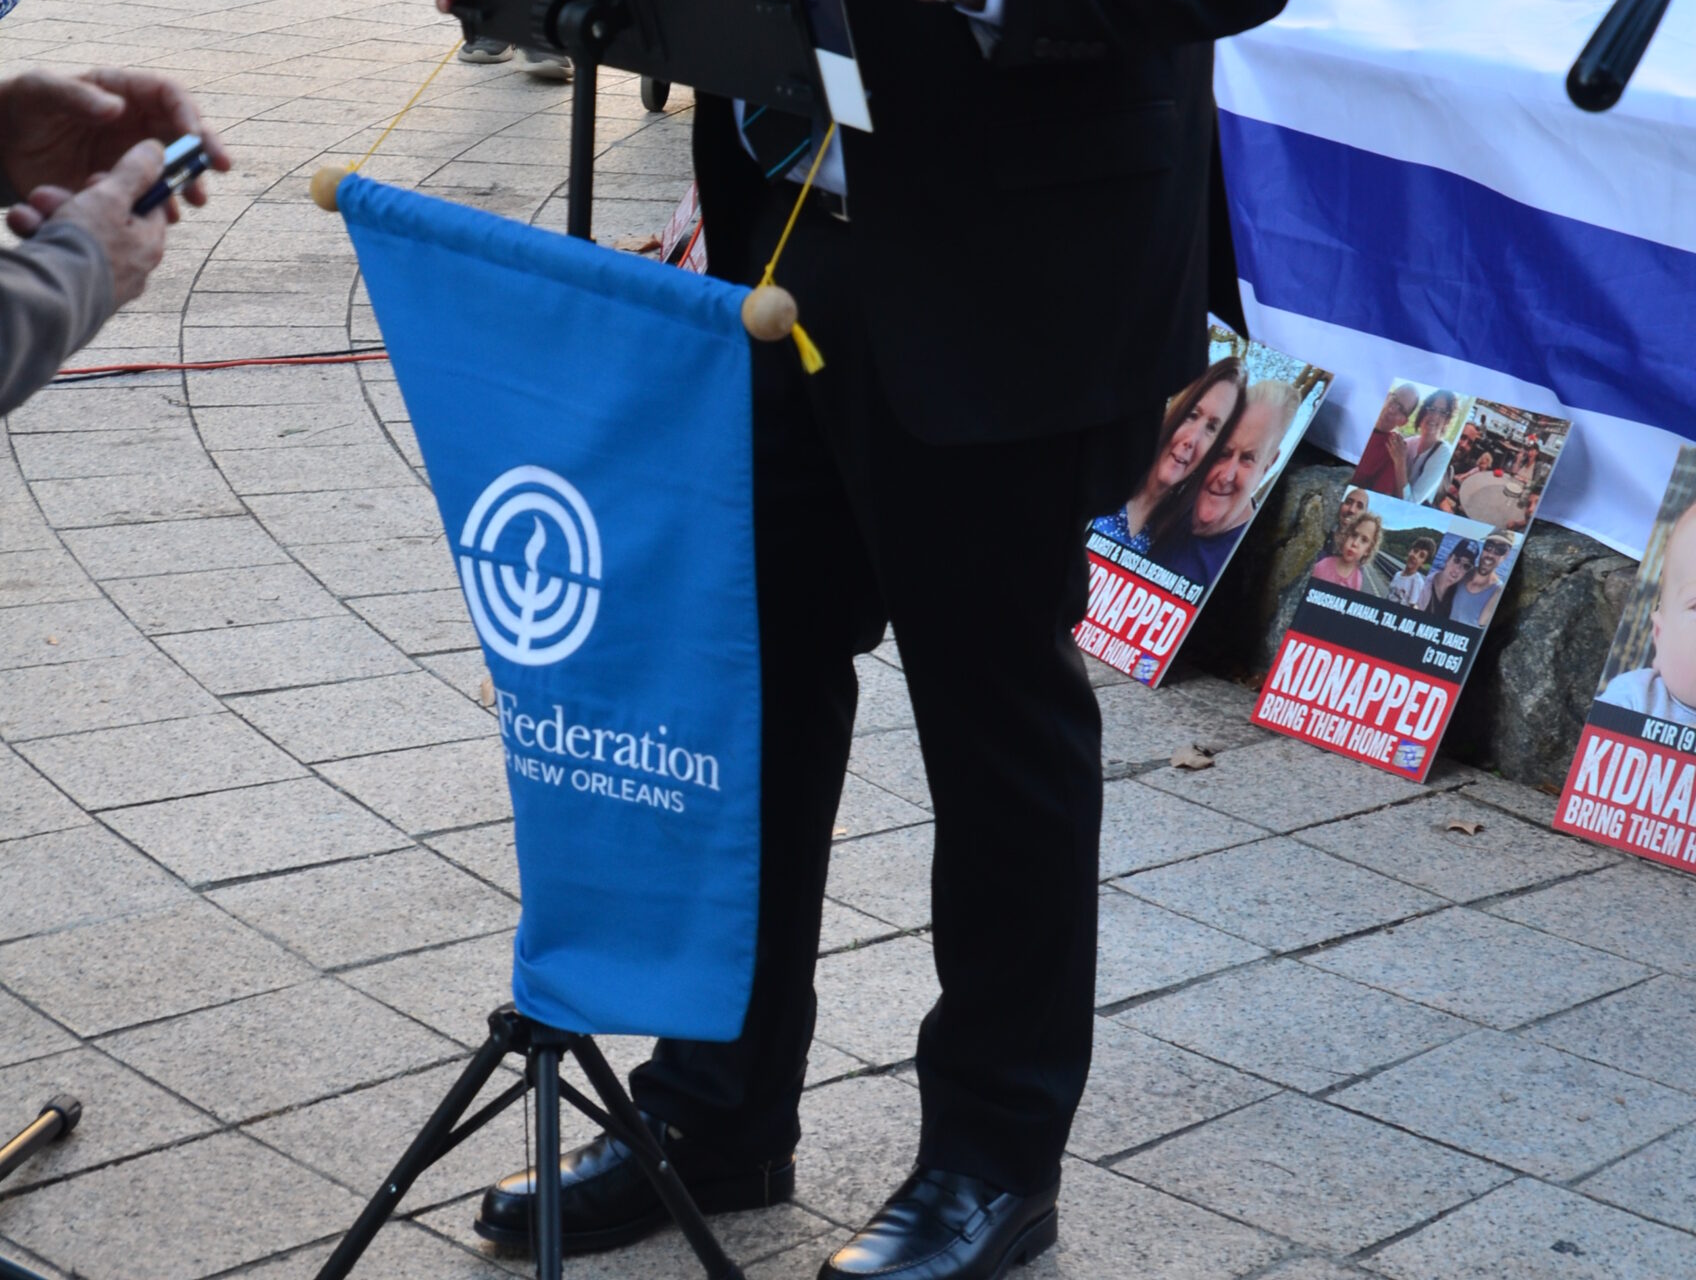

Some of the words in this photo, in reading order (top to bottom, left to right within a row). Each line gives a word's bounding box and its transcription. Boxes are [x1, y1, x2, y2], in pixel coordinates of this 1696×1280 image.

[1110, 545, 1122, 562] &
[1075, 620, 1111, 657] THEM
[1101, 636, 1141, 674] HOME
[1380, 611, 1397, 631] TAL,
[1398, 618, 1417, 637] ADI,
[1416, 623, 1442, 645] NAVE,
[1441, 631, 1470, 652] YAHEL
[1422, 646, 1436, 663] (3
[1433, 651, 1448, 667] TO
[1445, 654, 1463, 674] 65)
[1270, 638, 1448, 741] KIDNAPPED
[496, 687, 720, 791] Federation
[1257, 692, 1308, 733] BRING
[1305, 708, 1353, 747] THEM
[1347, 723, 1398, 764] HOME
[1641, 718, 1678, 747] KFIR
[1677, 726, 1695, 752] (9
[514, 754, 564, 787] NEW
[571, 768, 684, 813] ORLEANS
[1563, 794, 1626, 840] BRING
[1626, 813, 1686, 858] THEM
